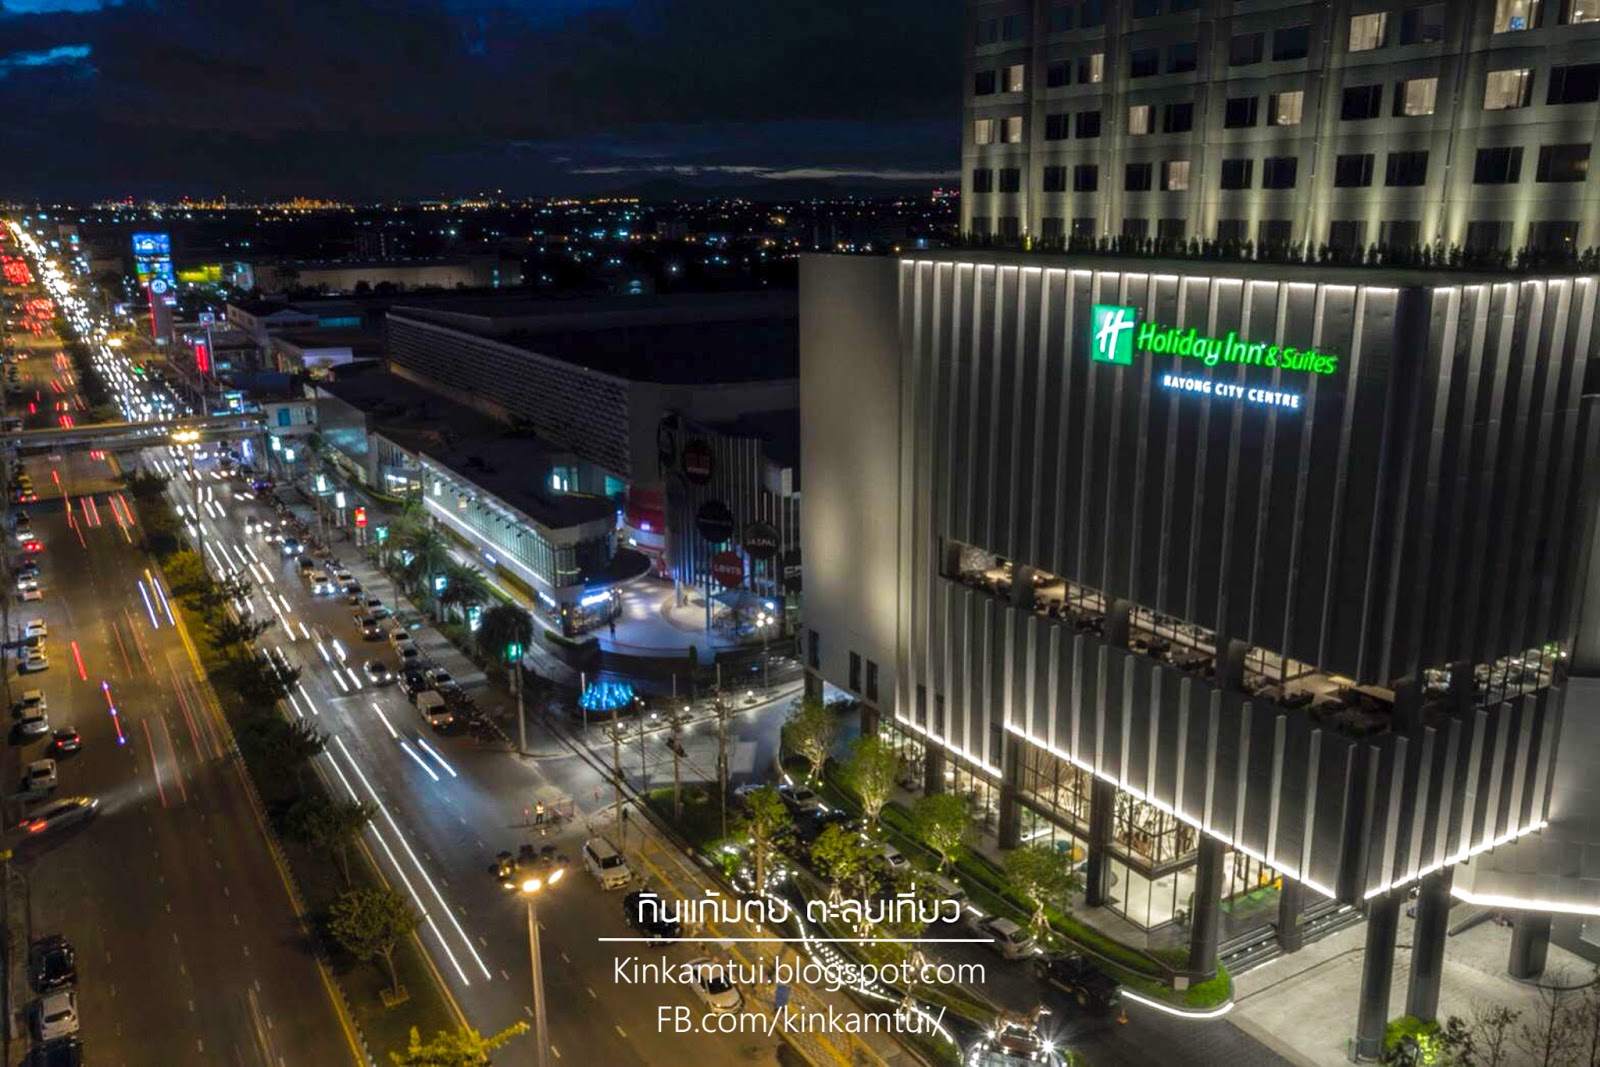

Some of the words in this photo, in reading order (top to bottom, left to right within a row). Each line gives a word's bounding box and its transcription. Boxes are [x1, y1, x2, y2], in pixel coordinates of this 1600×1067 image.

[1138, 322, 1222, 368] Holiday
[1225, 331, 1263, 366] Inn
[1265, 346, 1278, 367] &
[1281, 347, 1338, 375] Suites
[1164, 375, 1211, 394] RAYONG
[1215, 383, 1244, 400] CITY
[1248, 389, 1300, 409] CENTRE
